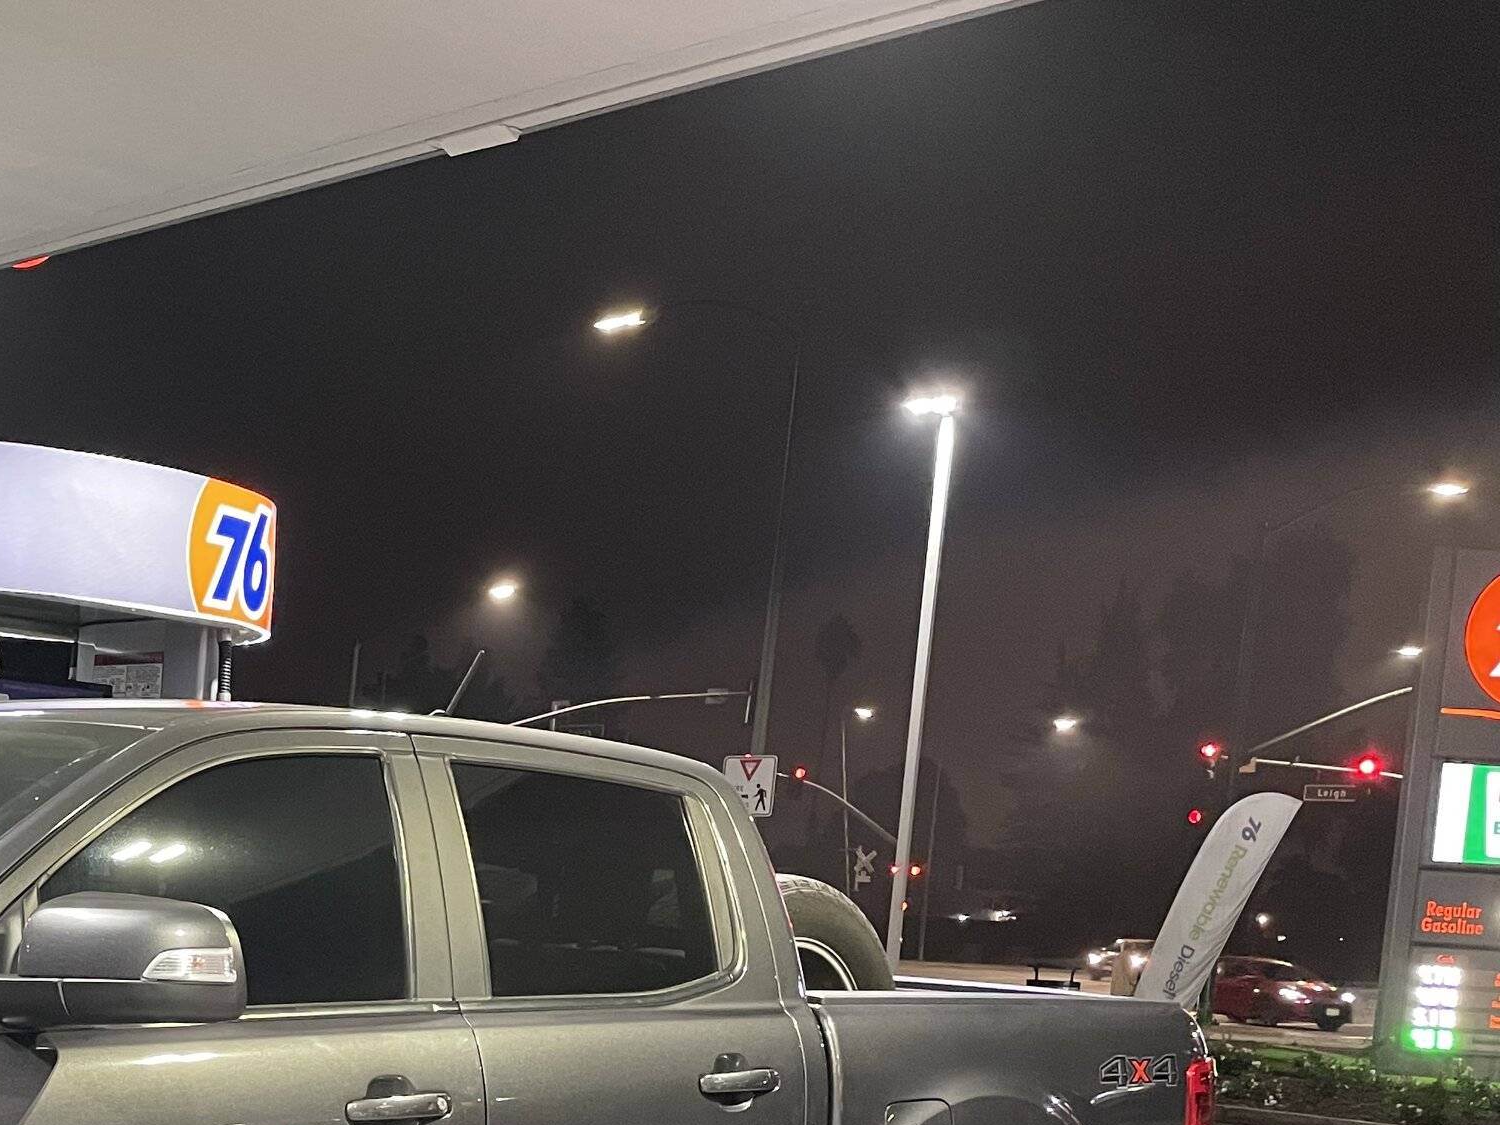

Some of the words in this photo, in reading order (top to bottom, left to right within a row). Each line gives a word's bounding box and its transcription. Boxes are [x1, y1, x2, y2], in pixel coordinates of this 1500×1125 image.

[209, 508, 270, 616] 76
[1241, 816, 1263, 842] 76
[1189, 844, 1248, 941] Renewable
[1426, 900, 1483, 921] Regular
[1421, 917, 1484, 935] Gasoline
[1162, 943, 1195, 1000] Diesel
